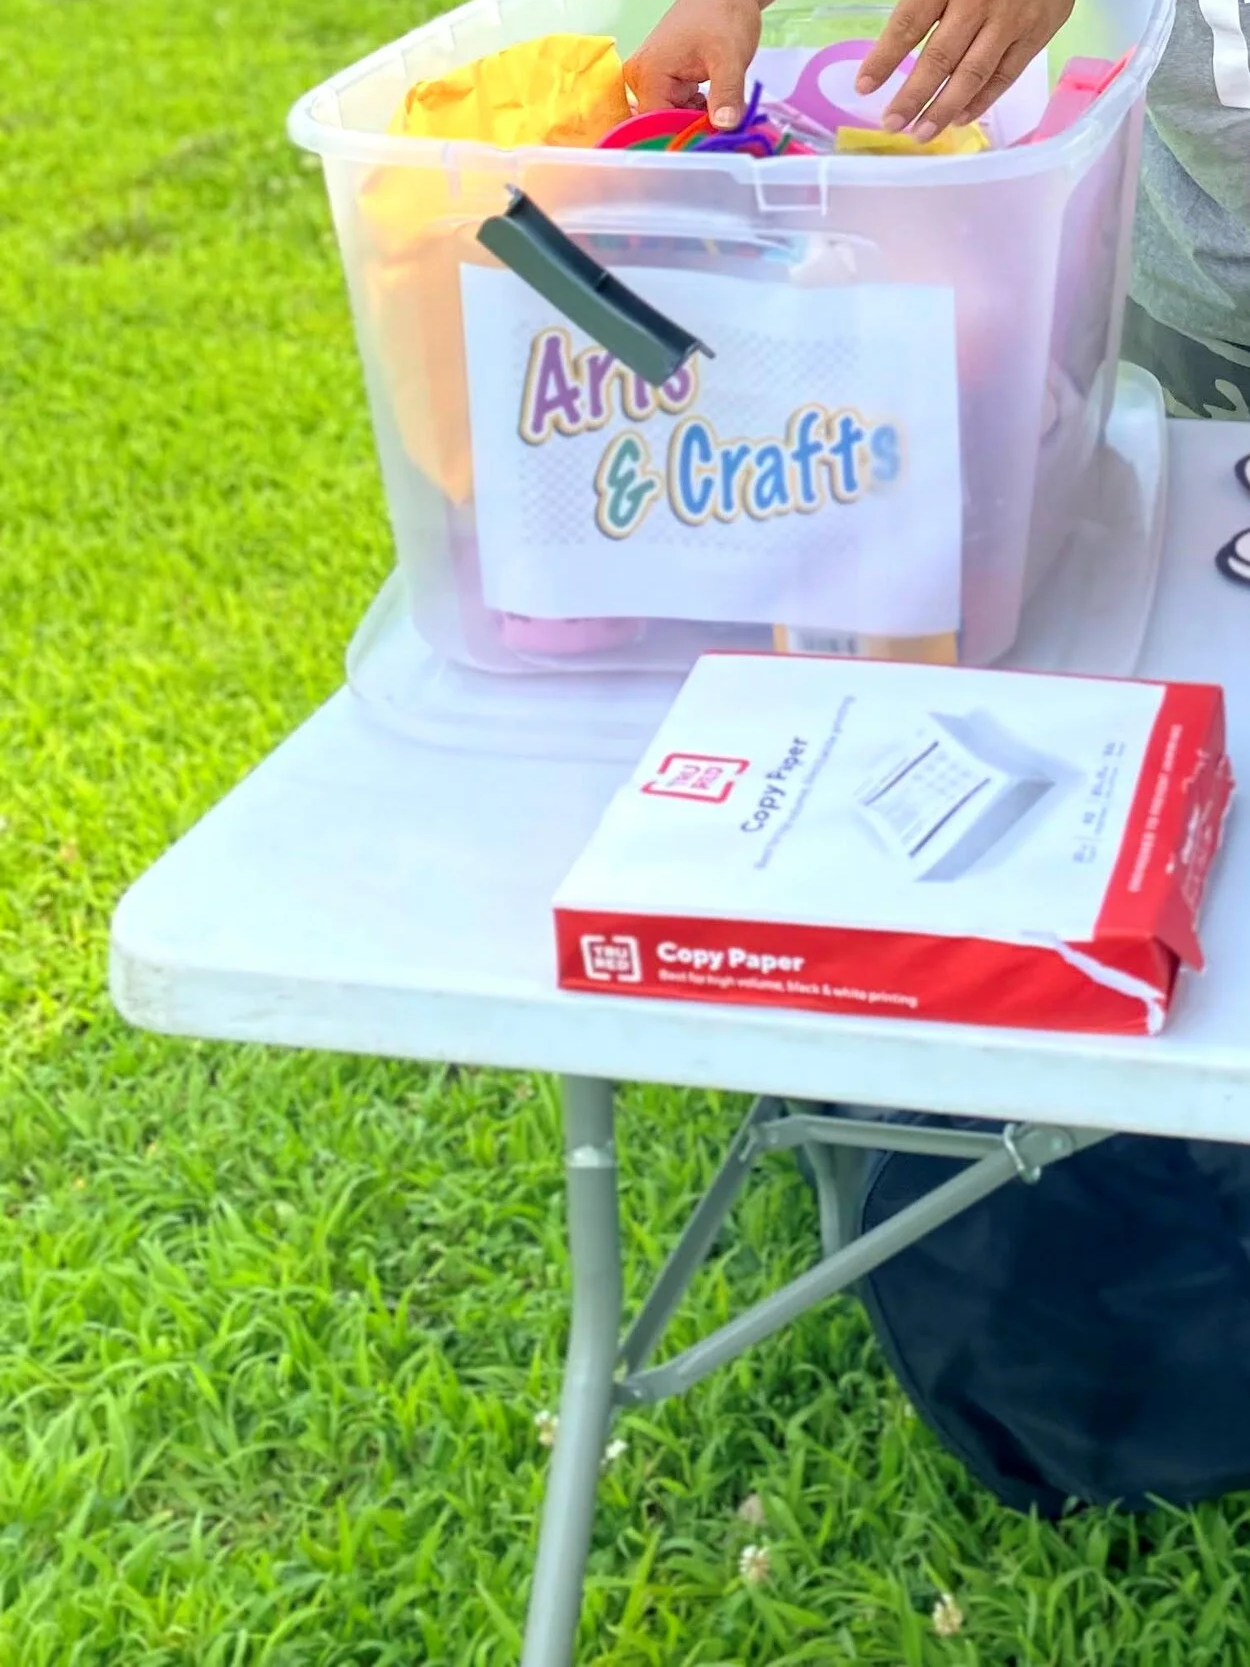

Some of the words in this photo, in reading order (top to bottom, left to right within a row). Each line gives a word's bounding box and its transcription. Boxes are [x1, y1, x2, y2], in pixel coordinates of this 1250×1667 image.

[600, 434, 660, 536] &
[672, 408, 903, 520] Crafts
[740, 784, 786, 833] Copy
[765, 735, 808, 780] Paper
[656, 940, 724, 971] Copy
[728, 947, 804, 974] Paper
[658, 968, 686, 982] Best
[688, 971, 706, 984] for
[707, 973, 734, 988] high
[787, 980, 820, 995] black
[822, 983, 831, 996] &
[833, 985, 867, 1001] white
[868, 990, 918, 1009] printing
